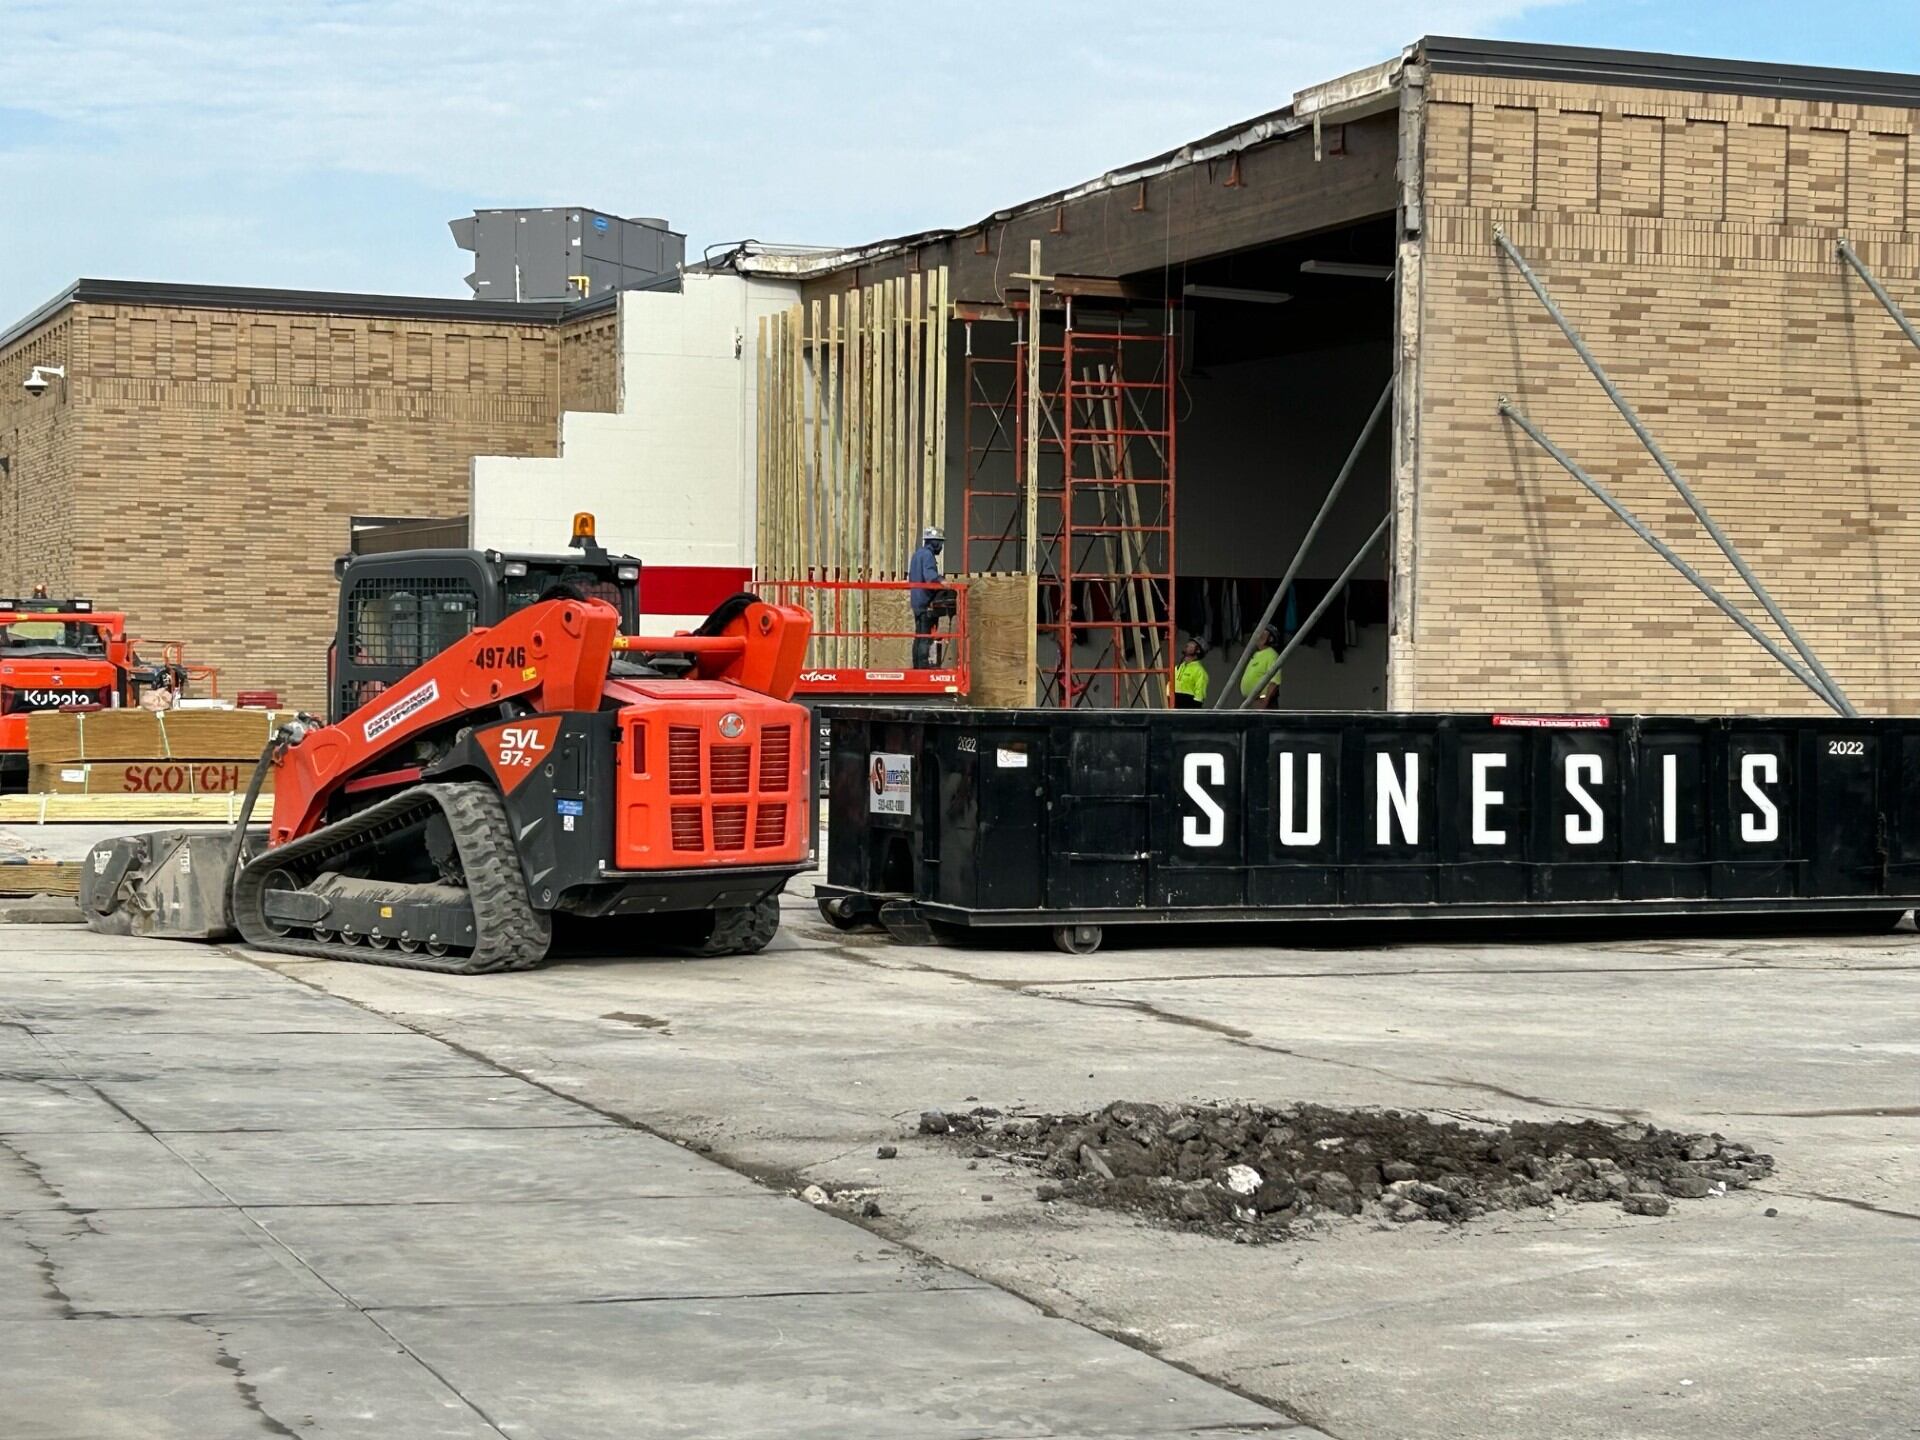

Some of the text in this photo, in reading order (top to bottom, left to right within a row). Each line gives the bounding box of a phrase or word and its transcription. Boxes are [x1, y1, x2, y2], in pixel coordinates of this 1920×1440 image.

[475, 646, 526, 669] 49746
[24, 690, 89, 705] Kubota
[499, 728, 545, 750] SVL
[1828, 740, 1864, 755] 2022
[123, 765, 239, 793] SCOTCH
[1183, 752, 1778, 847] SUNESIS
